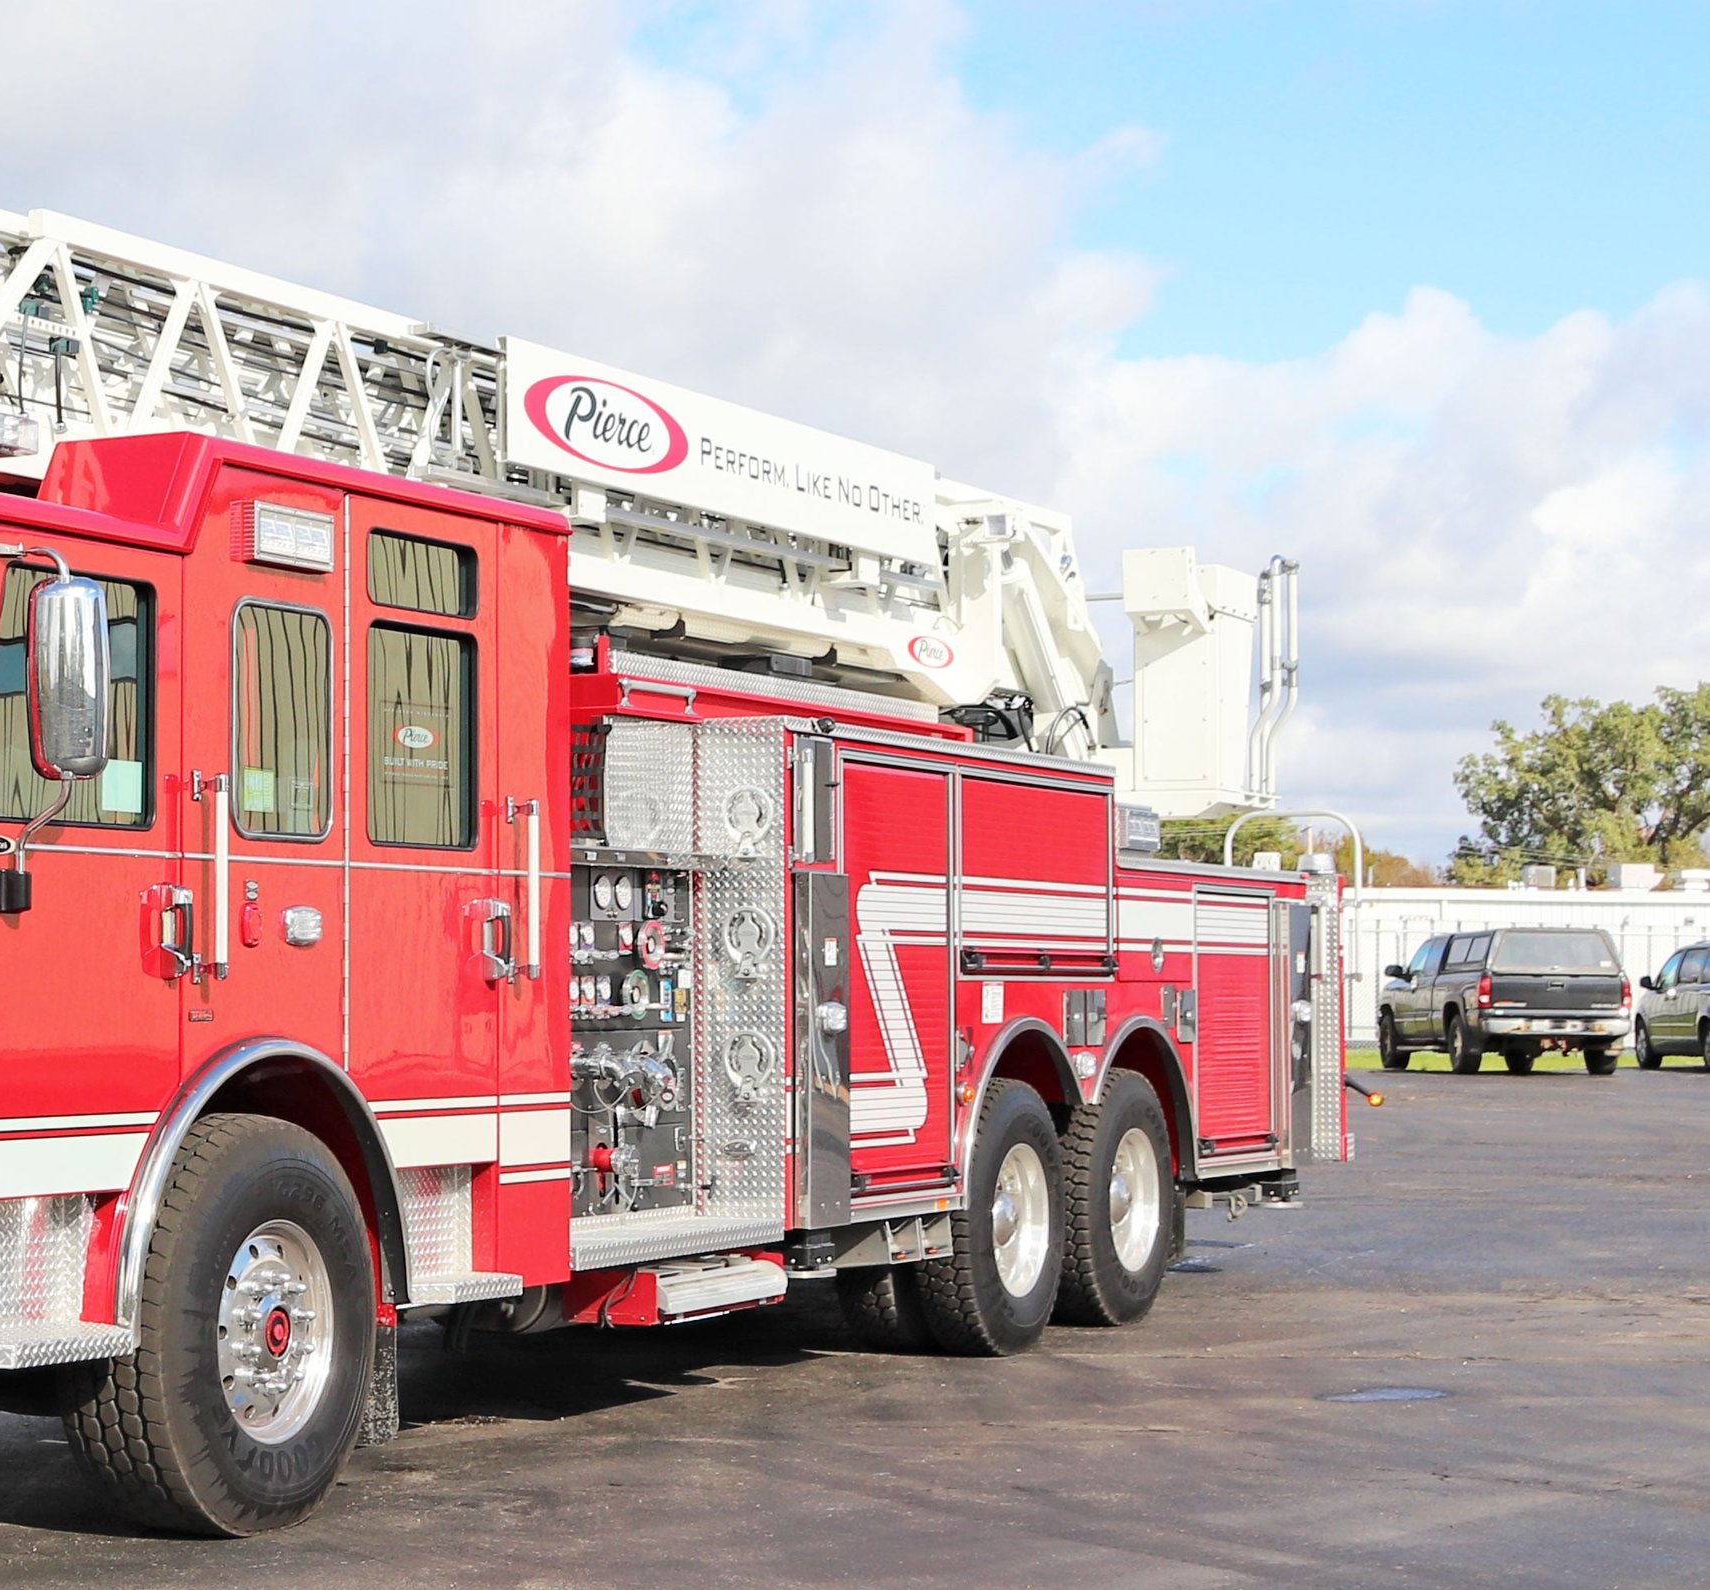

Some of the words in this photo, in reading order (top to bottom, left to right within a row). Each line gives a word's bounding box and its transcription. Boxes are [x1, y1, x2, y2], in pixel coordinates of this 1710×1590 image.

[564, 386, 652, 453] Pierce
[701, 437, 789, 489] PERFORM.
[796, 464, 832, 499] LIKE
[839, 475, 862, 508] NO
[384, 756, 405, 767] BUILT
[406, 758, 425, 768] WITH
[426, 760, 449, 770] PRIDE
